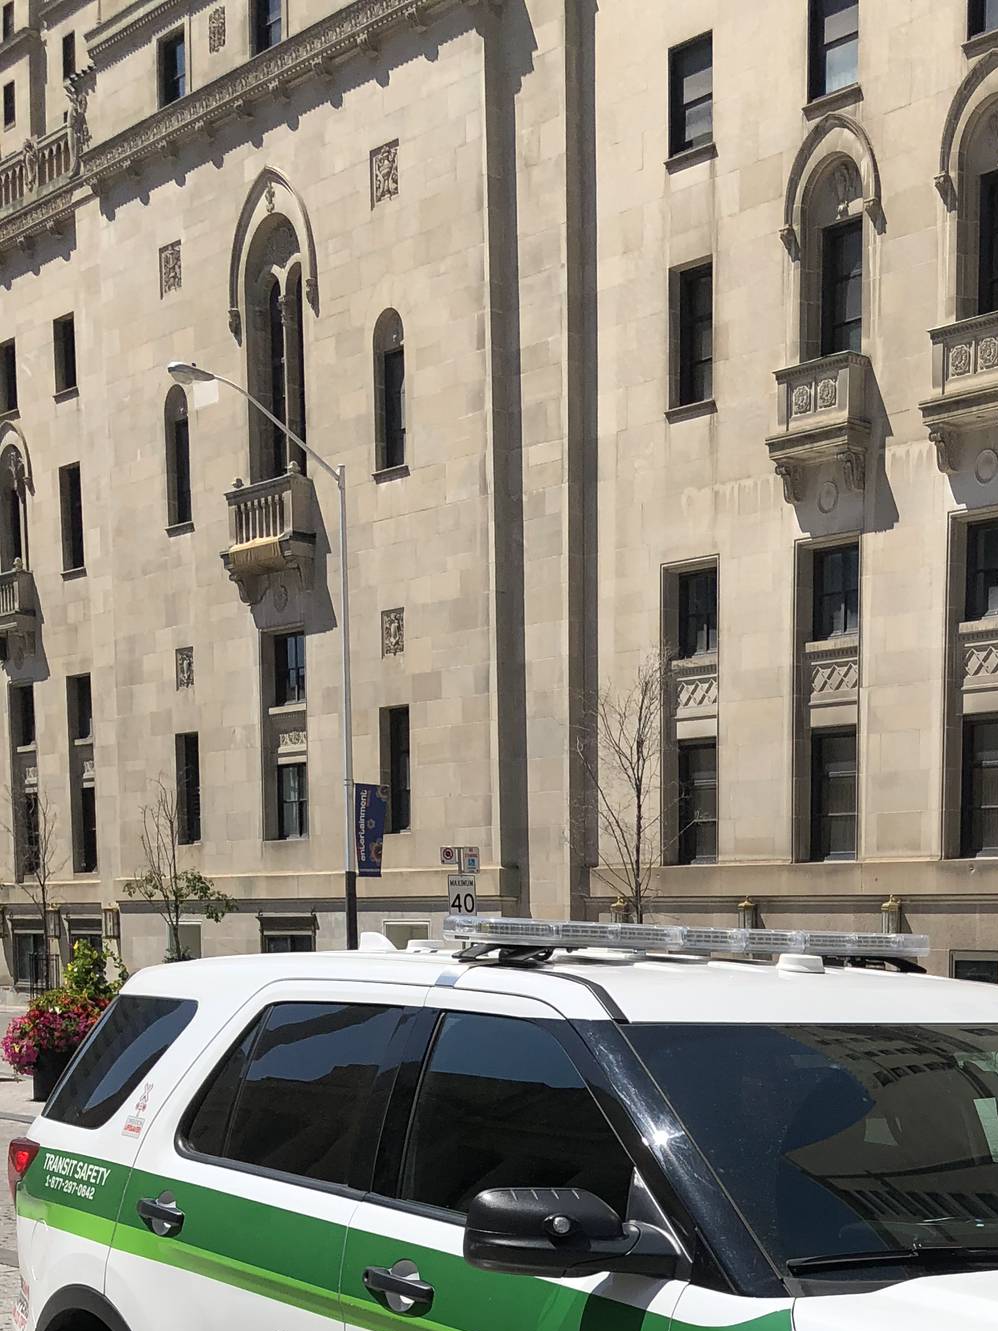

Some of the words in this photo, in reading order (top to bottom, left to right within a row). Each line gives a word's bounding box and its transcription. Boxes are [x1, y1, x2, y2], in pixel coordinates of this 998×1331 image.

[359, 789, 367, 861] entertainment
[451, 893, 475, 913] 40
[43, 1153, 78, 1177] TRANSIT
[74, 1162, 111, 1186] SAFETY
